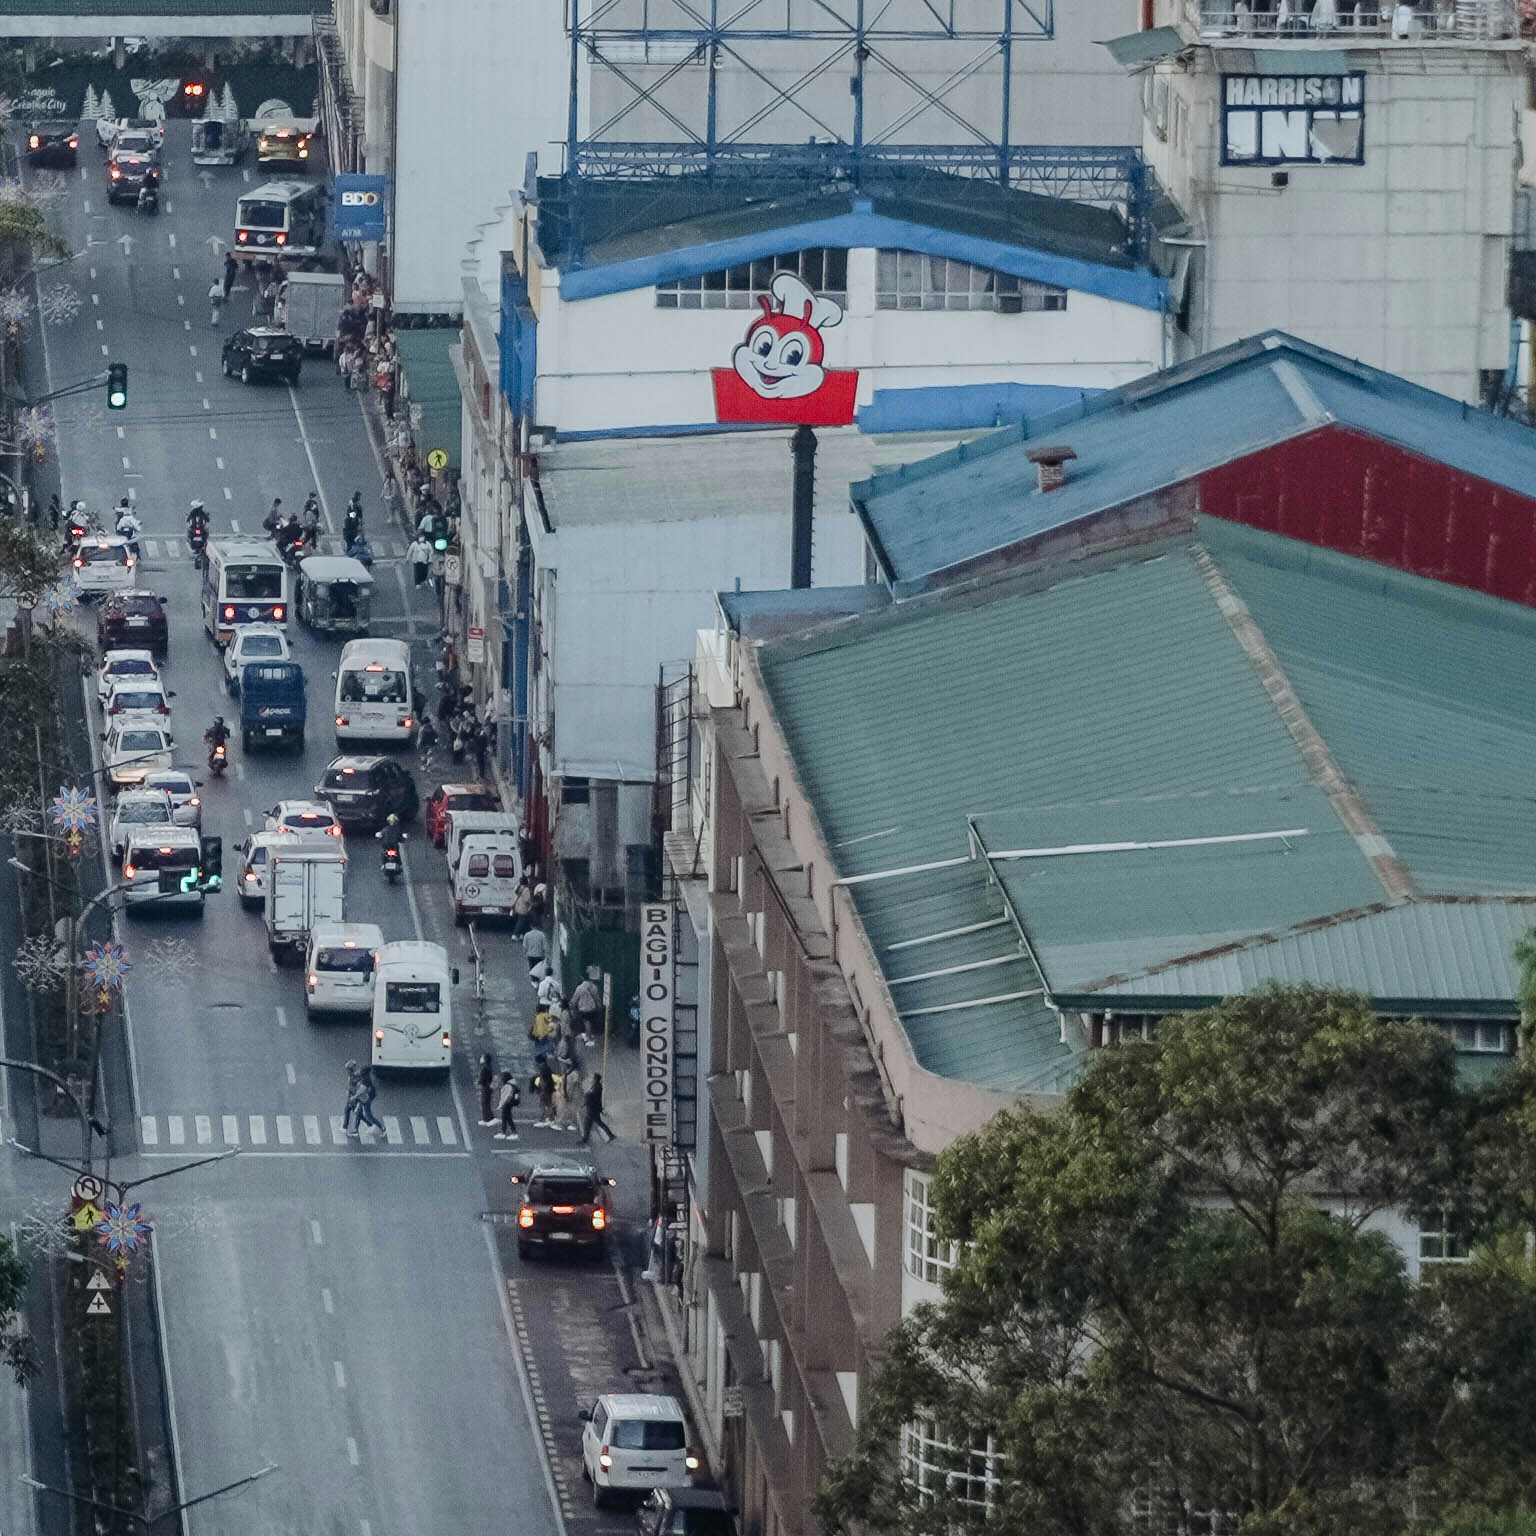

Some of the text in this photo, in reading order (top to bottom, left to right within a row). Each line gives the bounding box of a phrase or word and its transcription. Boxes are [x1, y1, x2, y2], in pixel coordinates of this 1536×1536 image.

[1226, 77, 1360, 105] HARRISON
[341, 191, 378, 206] BDO
[646, 909, 668, 1140] BAGUIO CONDOTEL
